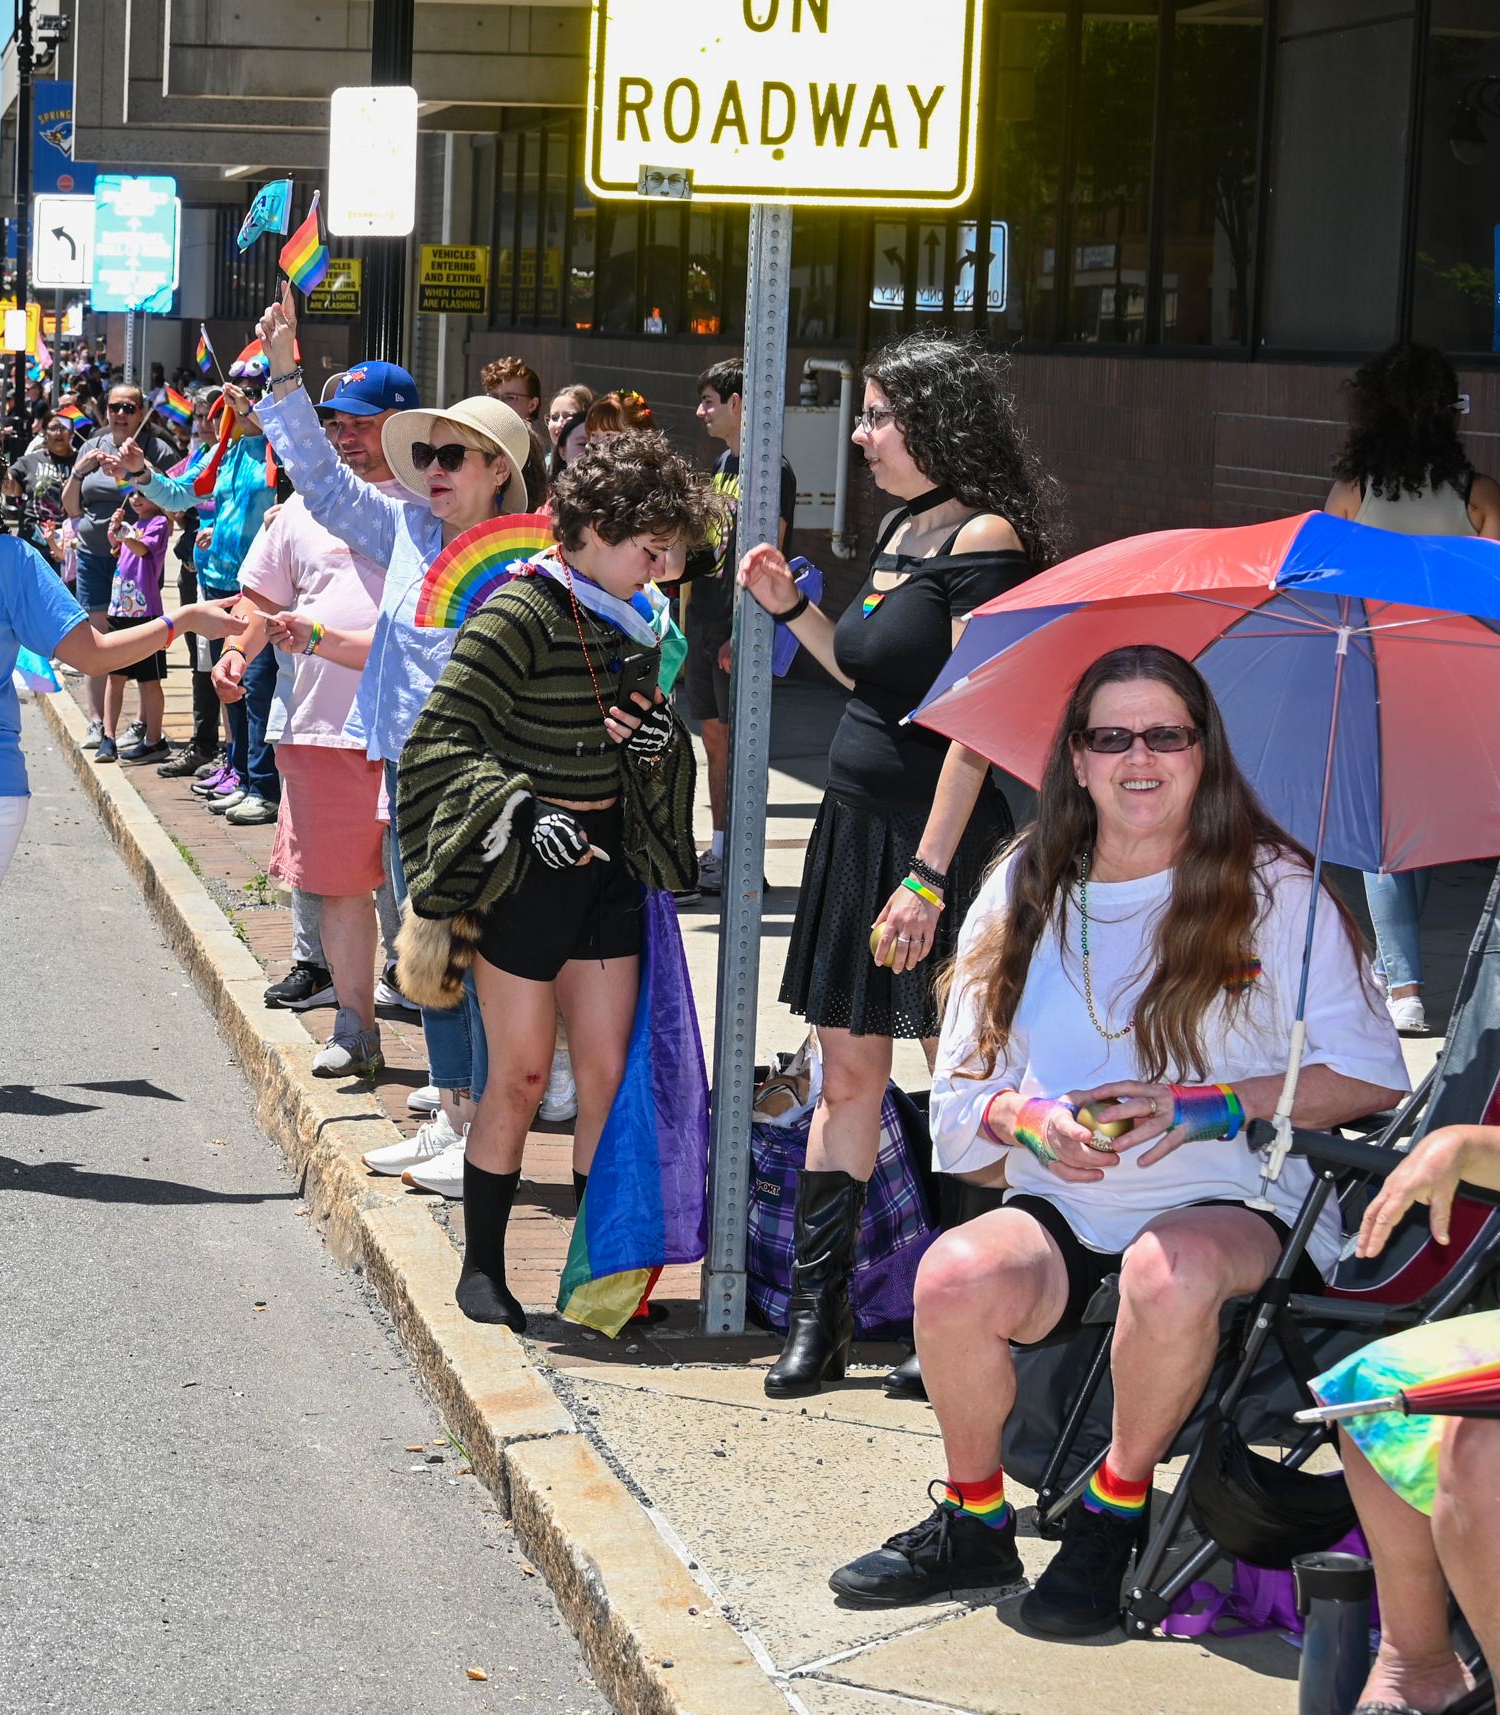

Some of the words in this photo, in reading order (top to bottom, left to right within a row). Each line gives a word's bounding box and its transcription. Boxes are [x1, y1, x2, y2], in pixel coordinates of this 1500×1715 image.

[38, 109, 73, 124] SPRING
[617, 77, 946, 150] ROADWAY
[432, 249, 476, 260] VEHICLES
[431, 261, 476, 271] ENTERING
[424, 273, 443, 282] AND
[446, 273, 482, 283] EXITING
[424, 288, 449, 297] WHEN
[451, 288, 480, 298] LIGHTS
[423, 299, 440, 308] ARE
[441, 299, 480, 310] FLASHING
[756, 1178, 780, 1196] PORT
